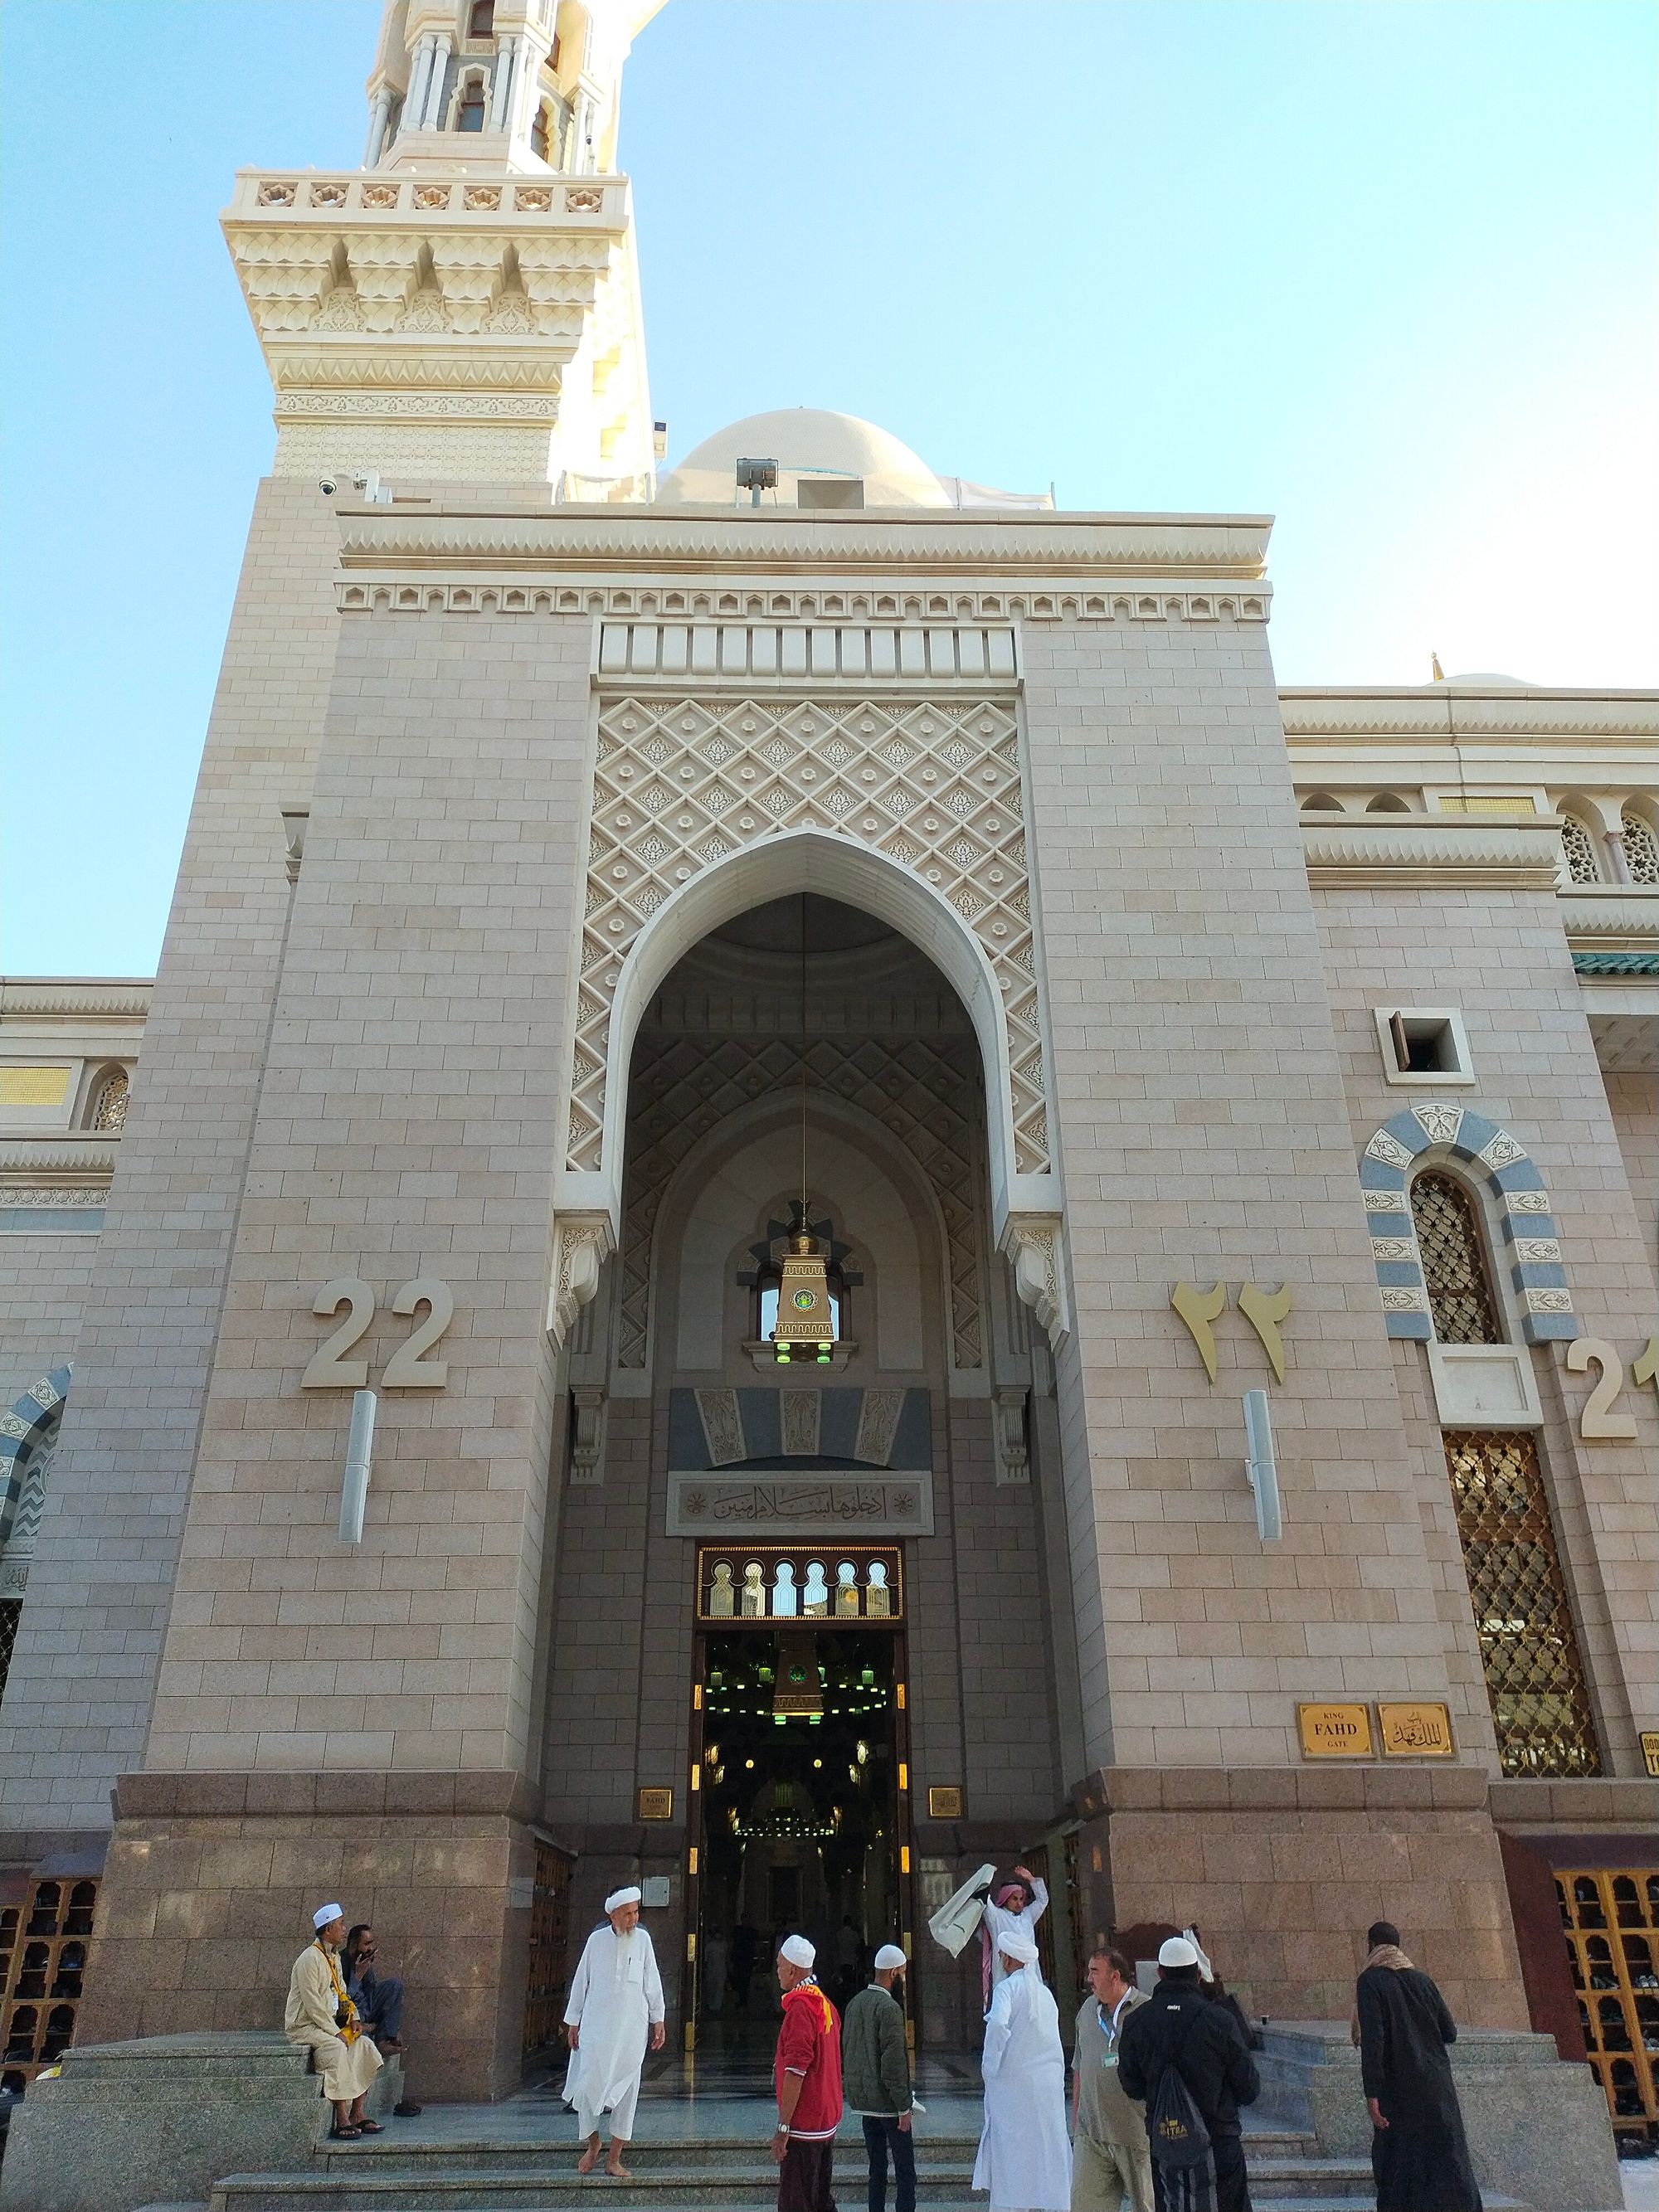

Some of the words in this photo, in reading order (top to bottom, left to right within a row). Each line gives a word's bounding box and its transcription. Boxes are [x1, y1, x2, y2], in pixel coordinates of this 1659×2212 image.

[300, 1278, 454, 1388] 22
[1171, 1280, 1292, 1386] ٢٢
[1314, 1723, 1357, 1736] FAHD
[1327, 1740, 1349, 1748] GATE
